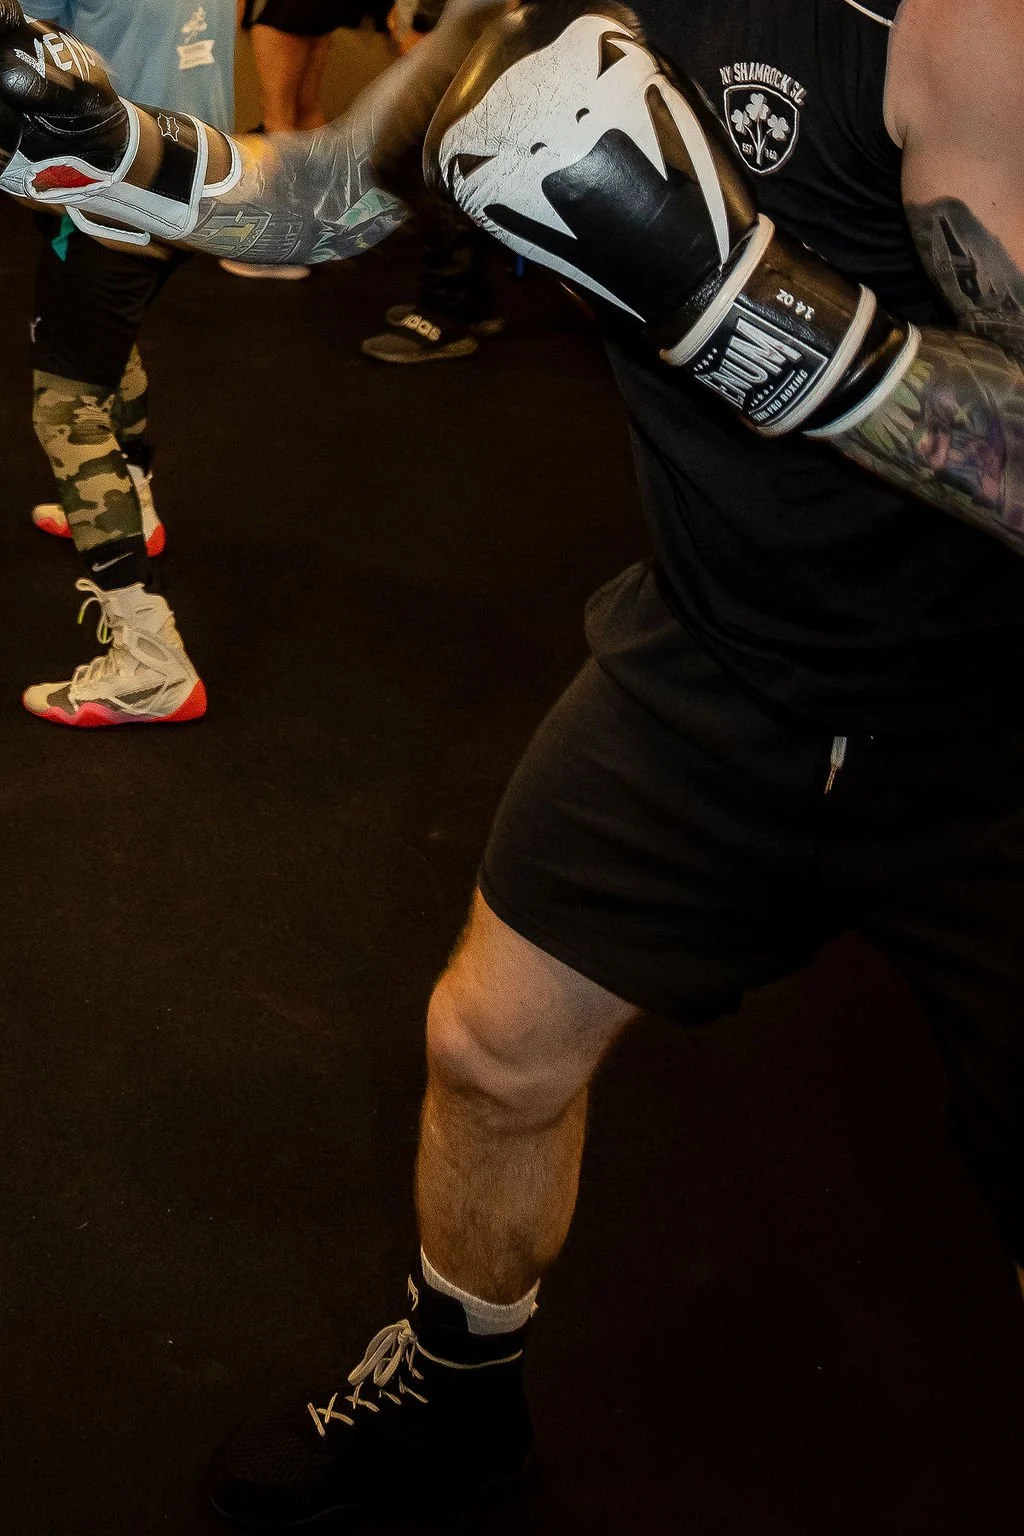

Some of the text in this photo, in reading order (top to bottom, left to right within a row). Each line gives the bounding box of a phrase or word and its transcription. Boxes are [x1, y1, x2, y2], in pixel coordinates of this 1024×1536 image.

[14, 26, 96, 82] VENU
[719, 66, 733, 84] NY
[733, 63, 792, 93] SHAMROCK
[780, 369, 809, 403] BOXING
